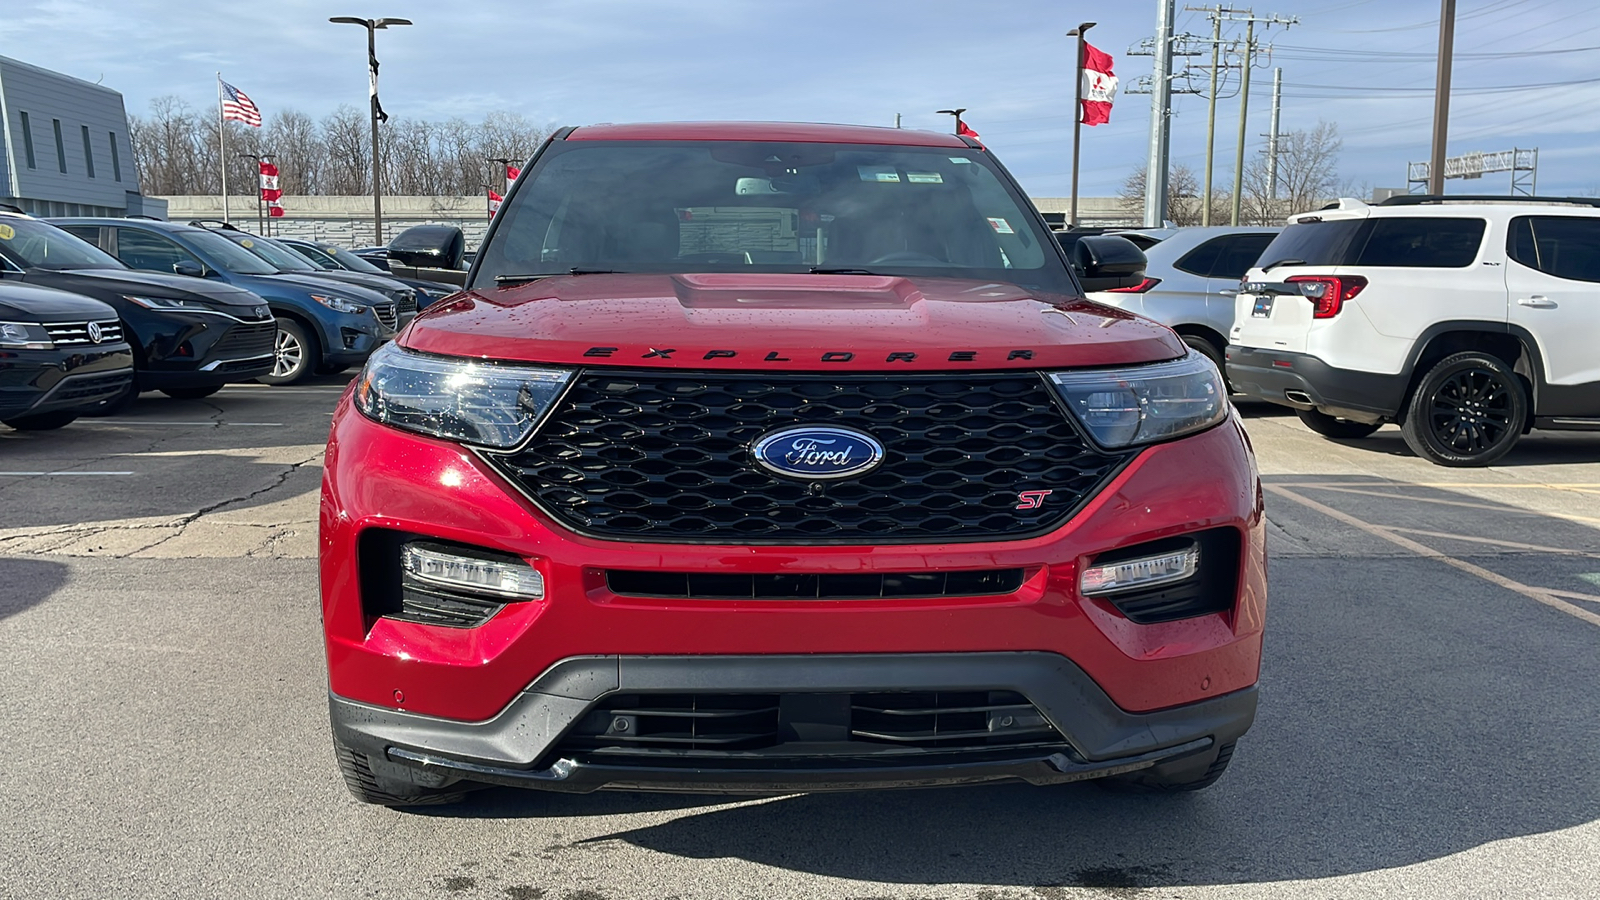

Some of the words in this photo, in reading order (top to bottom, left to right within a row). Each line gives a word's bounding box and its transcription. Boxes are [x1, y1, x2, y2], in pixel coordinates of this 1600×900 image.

[583, 346, 1036, 362] EXPLORER
[785, 437, 853, 466] Ford
[1016, 489, 1053, 510] ST
